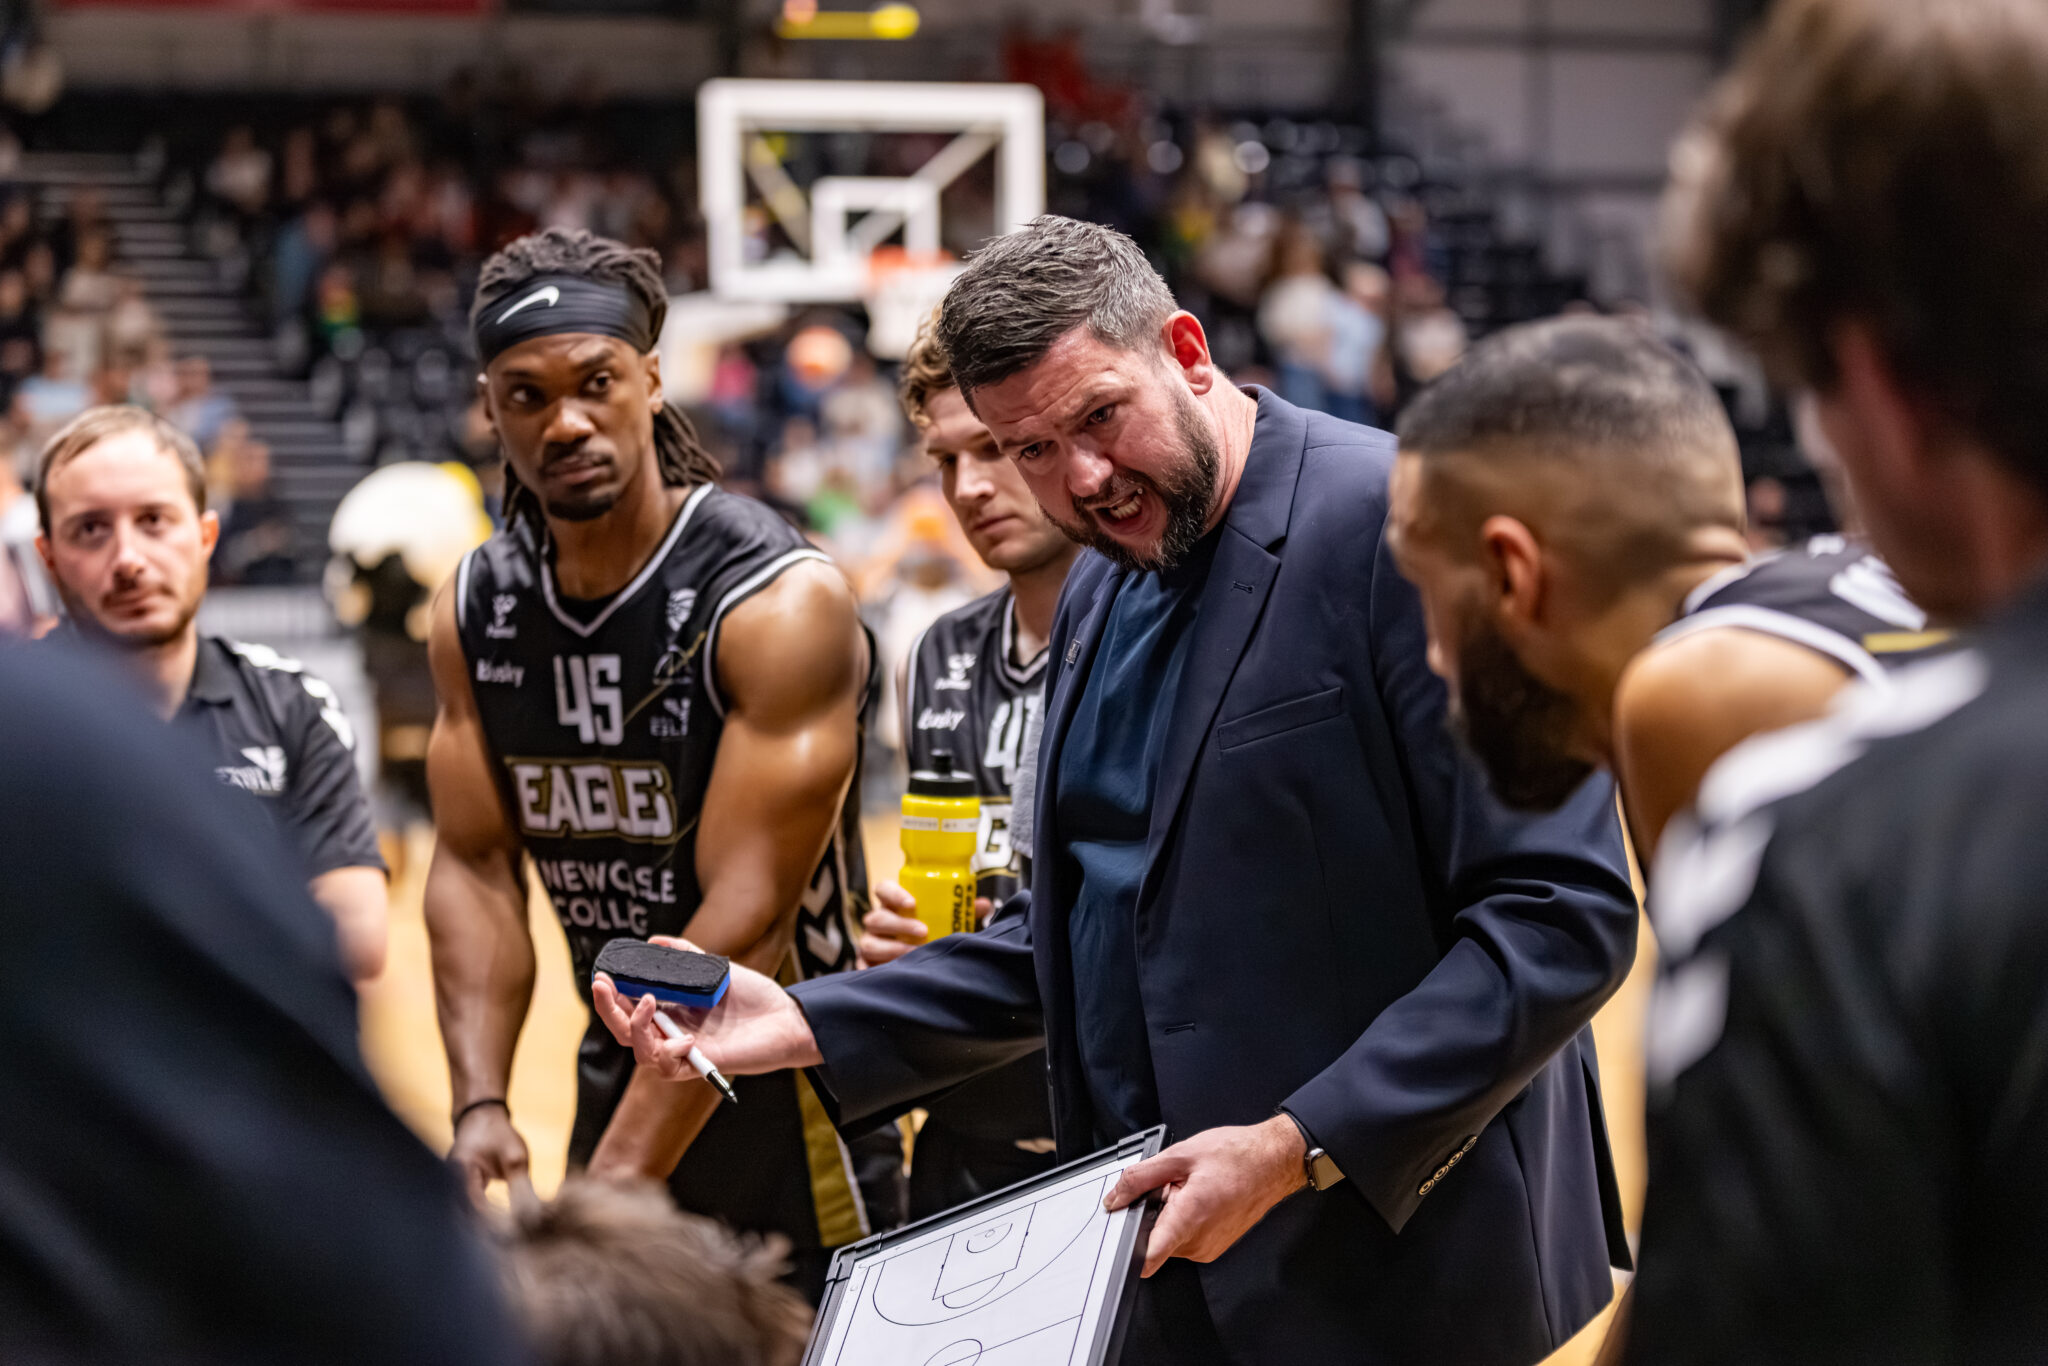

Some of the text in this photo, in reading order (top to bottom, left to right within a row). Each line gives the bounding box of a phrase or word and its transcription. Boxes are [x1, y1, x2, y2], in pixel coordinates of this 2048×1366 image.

[553, 653, 624, 746] 45
[539, 859, 677, 904] NEWCSLE
[553, 897, 649, 937] COLLG
[952, 883, 964, 933] ORLD
